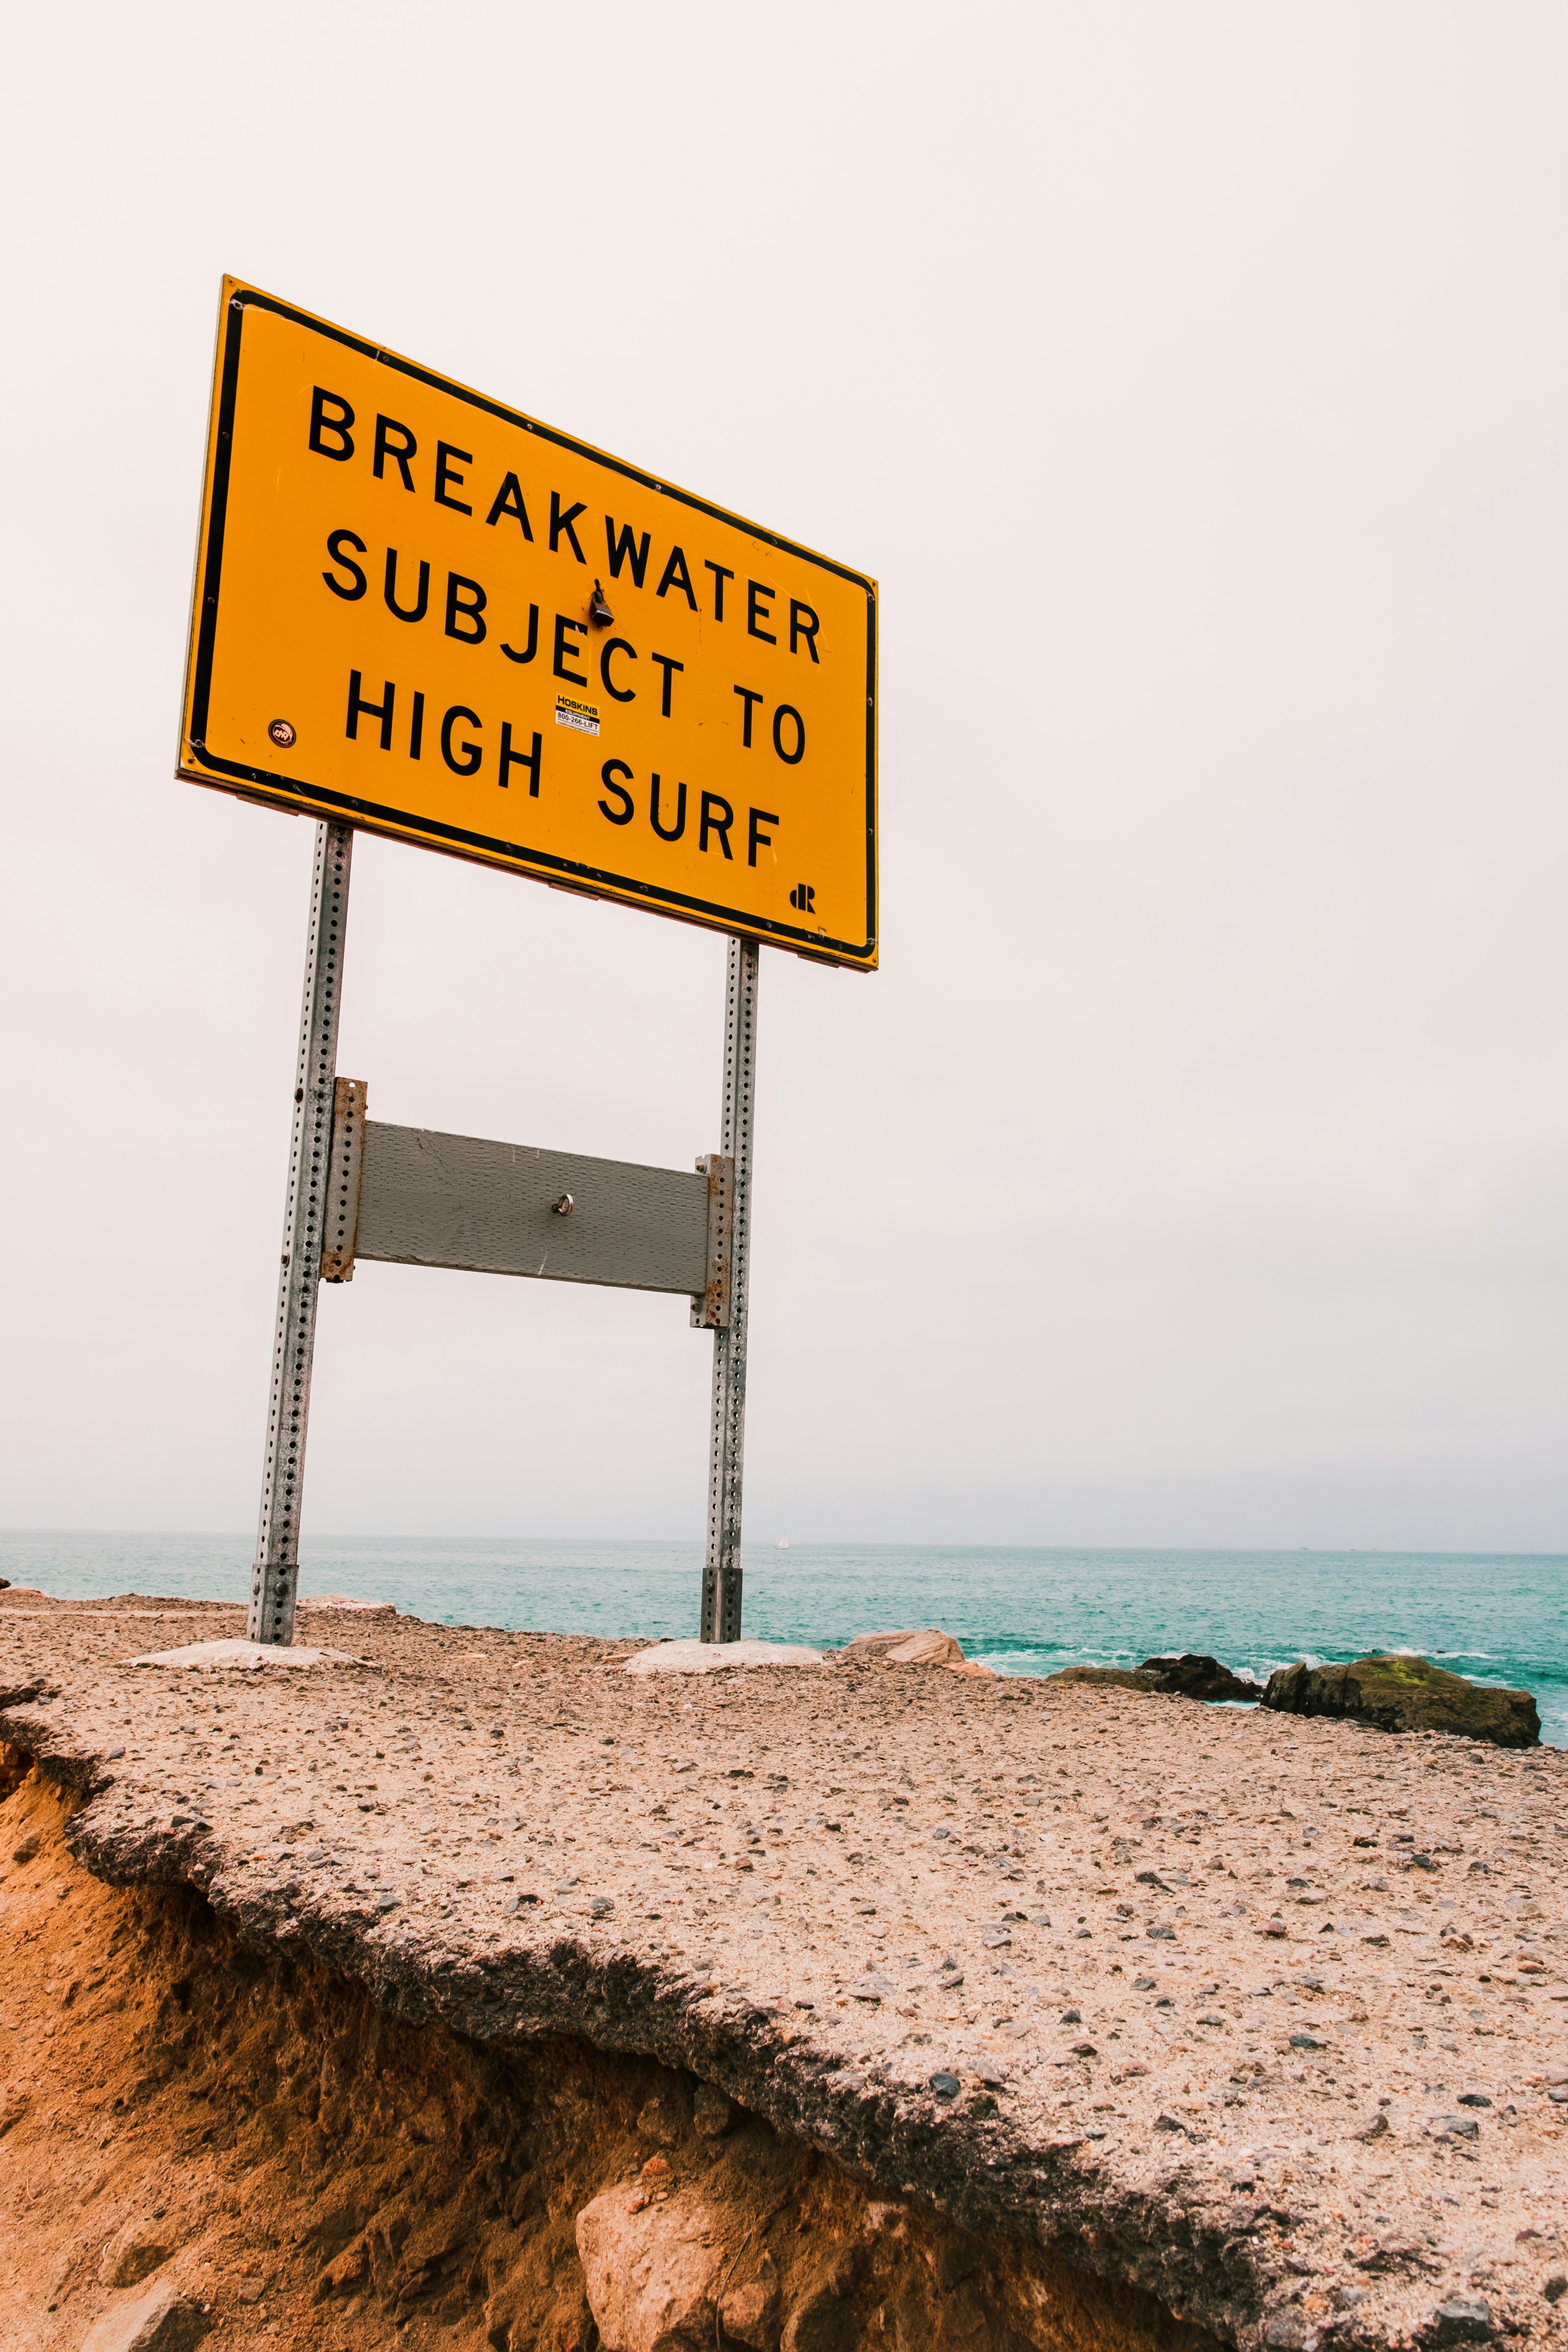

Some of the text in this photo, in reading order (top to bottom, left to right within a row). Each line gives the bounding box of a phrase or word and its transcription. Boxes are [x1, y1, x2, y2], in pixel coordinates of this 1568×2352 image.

[309, 386, 820, 664] BREAKWATER
[322, 529, 805, 765] SUBJECT TO
[557, 695, 598, 716] HOSKINS
[557, 712, 598, 730] 800-266-LIFT
[565, 709, 590, 720] EQUIPMENT
[345, 669, 779, 867] HIGH SURF
